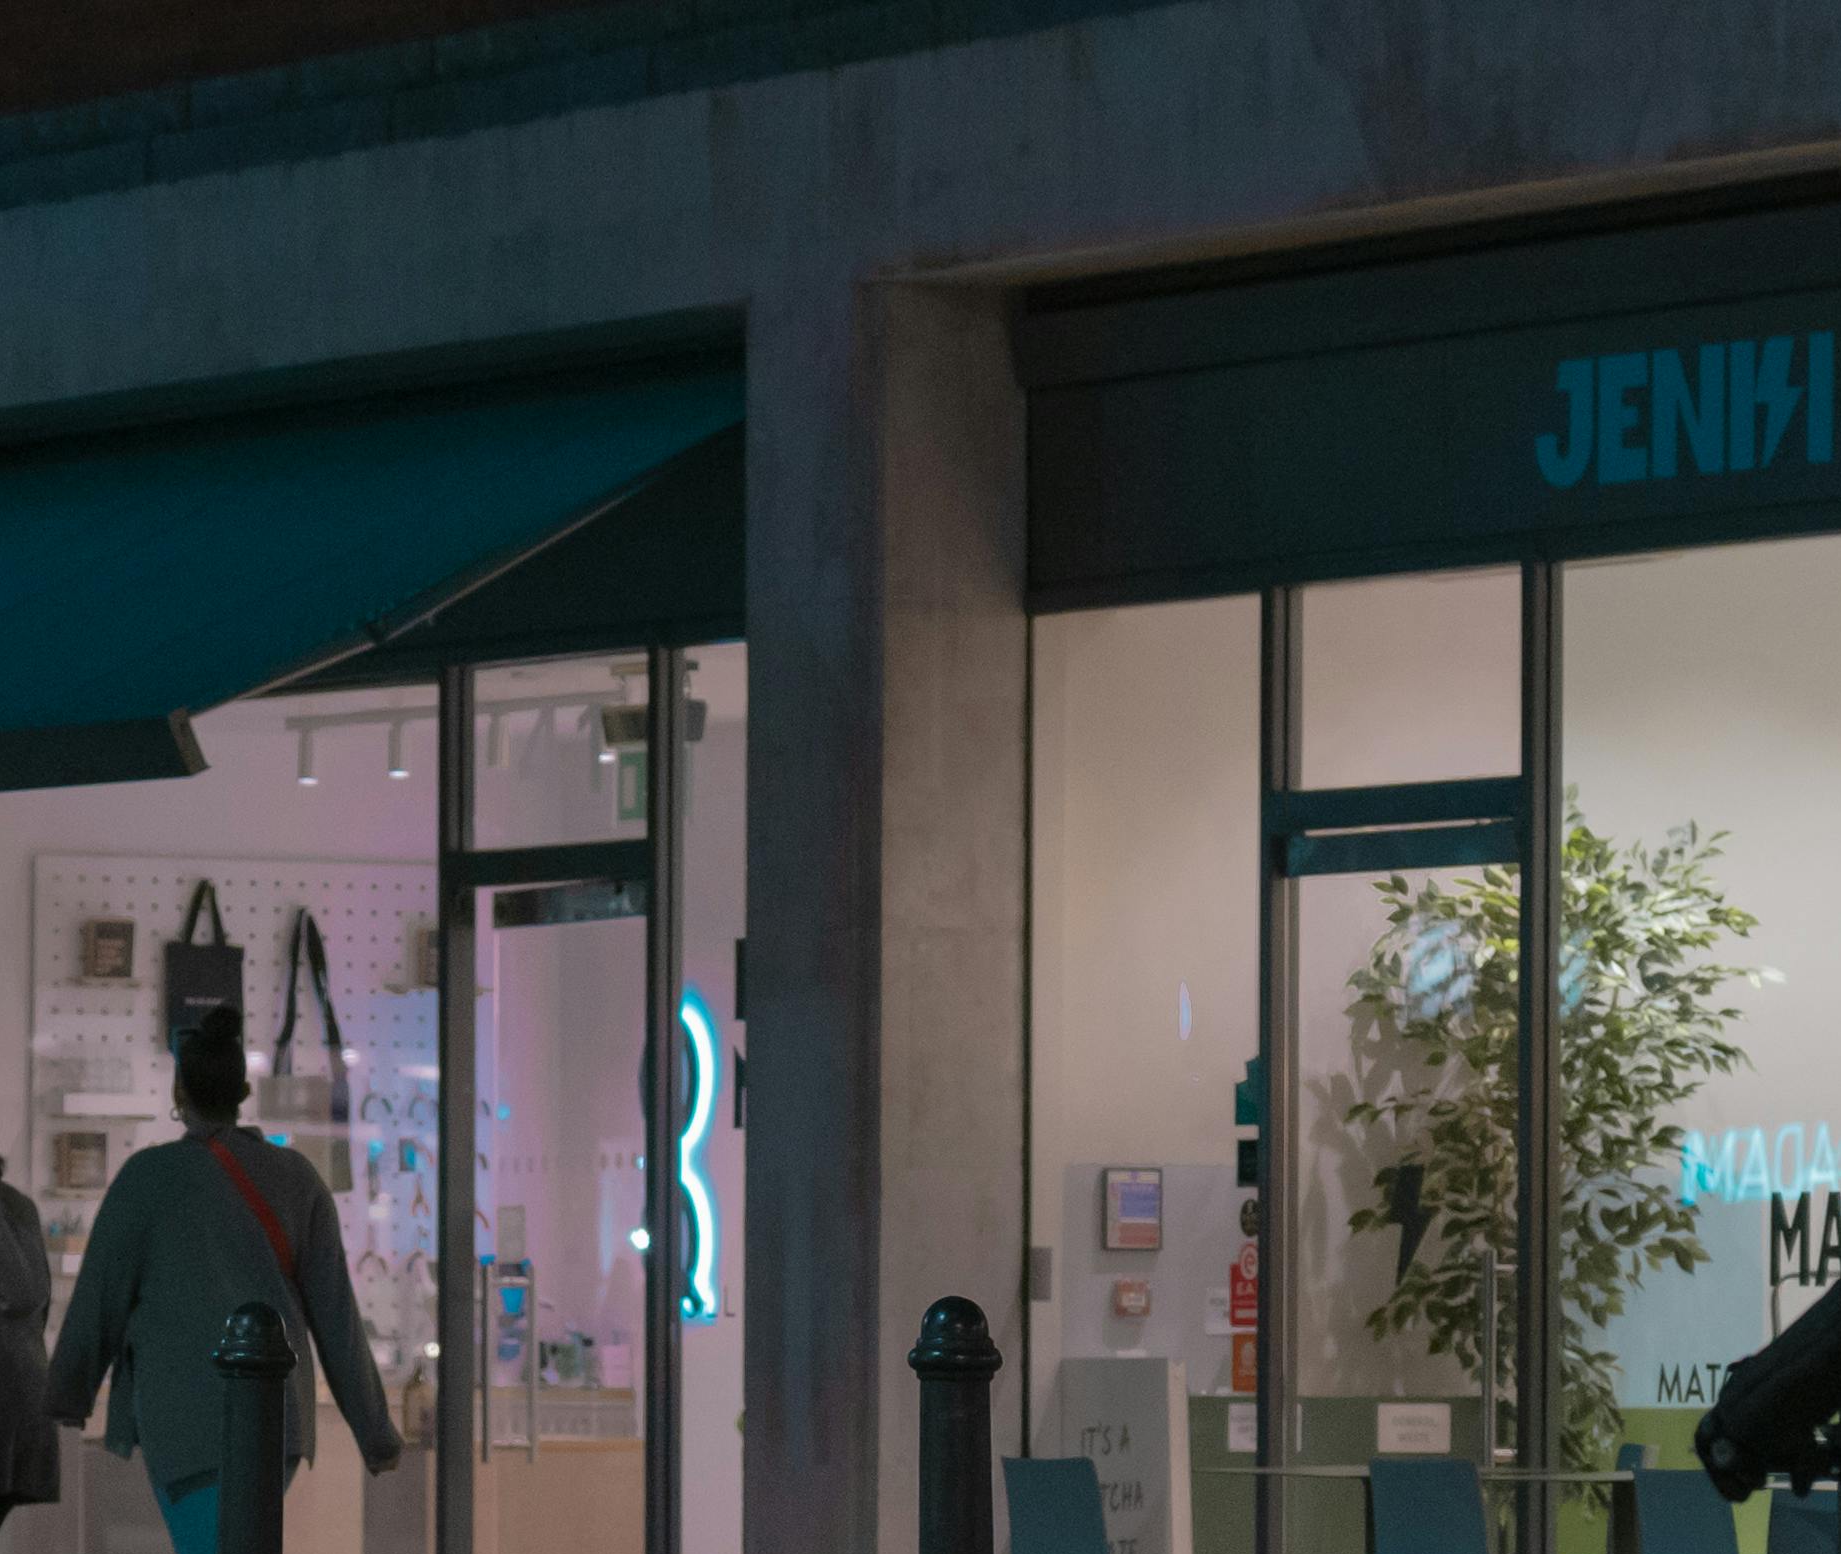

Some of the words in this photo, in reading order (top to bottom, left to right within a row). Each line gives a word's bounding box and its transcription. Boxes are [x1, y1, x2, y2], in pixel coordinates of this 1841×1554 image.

[1534, 330, 1835, 488] JENKI
[1657, 1363, 1732, 1404] MAT
[1099, 1480, 1144, 1513] TCHA
